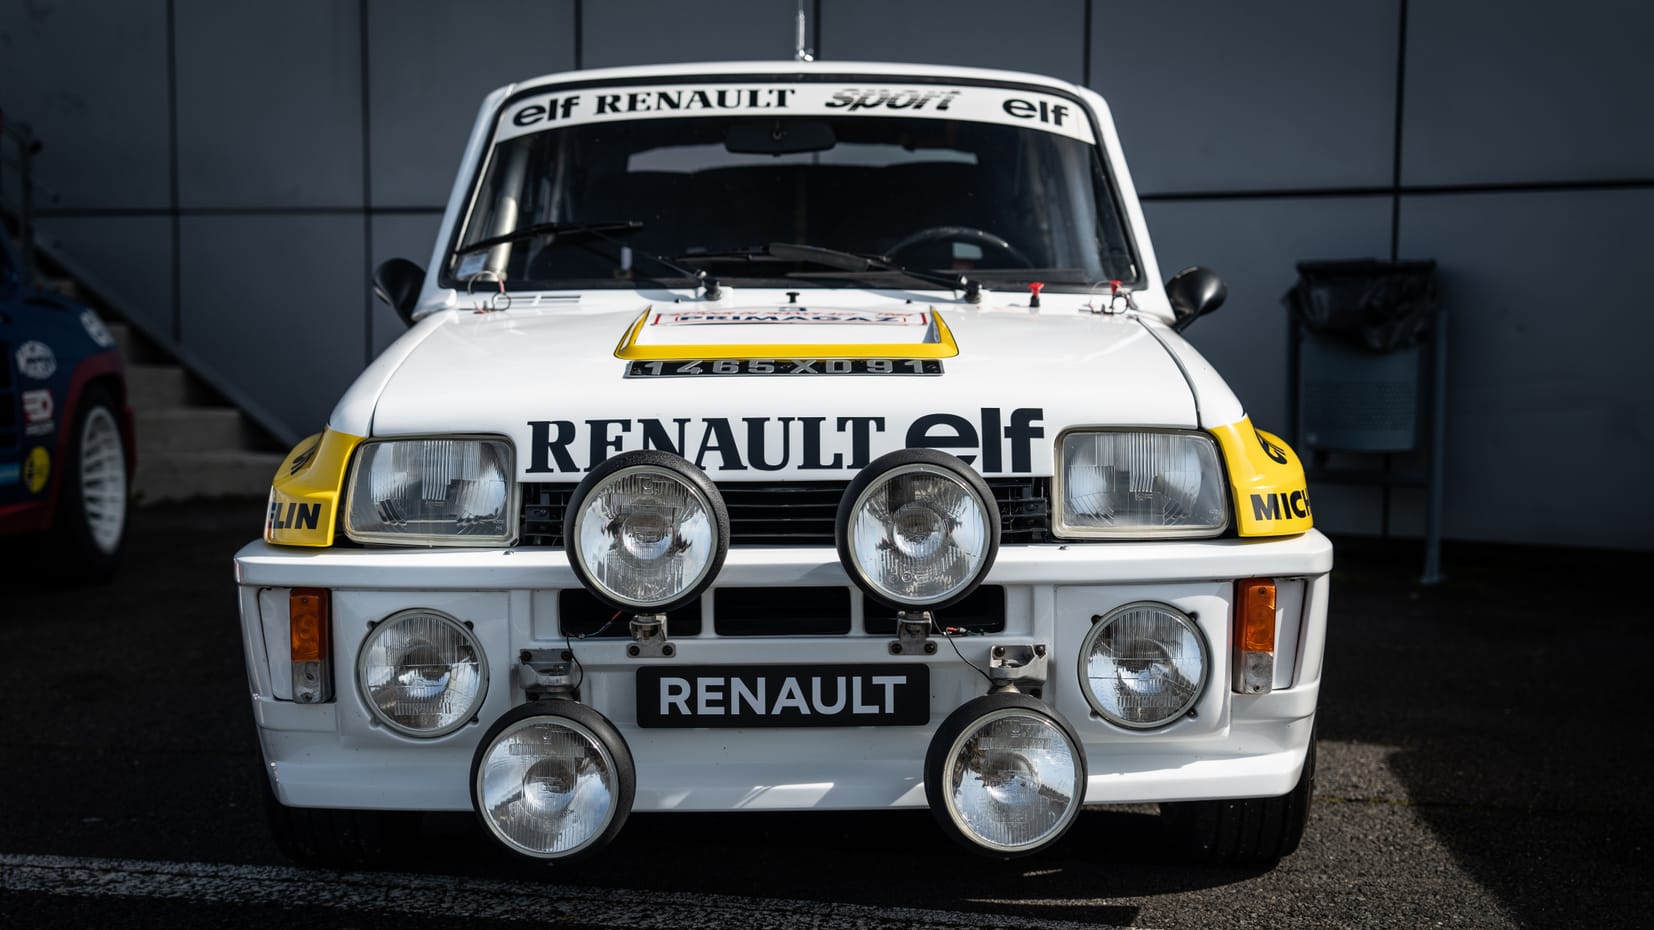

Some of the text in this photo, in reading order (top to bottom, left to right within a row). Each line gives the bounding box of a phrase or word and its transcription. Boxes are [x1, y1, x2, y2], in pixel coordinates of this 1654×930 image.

[512, 88, 1069, 127] elf RENAULT sport elf
[526, 407, 1045, 474] RENAULT elf
[659, 675, 907, 716] RENAULT
